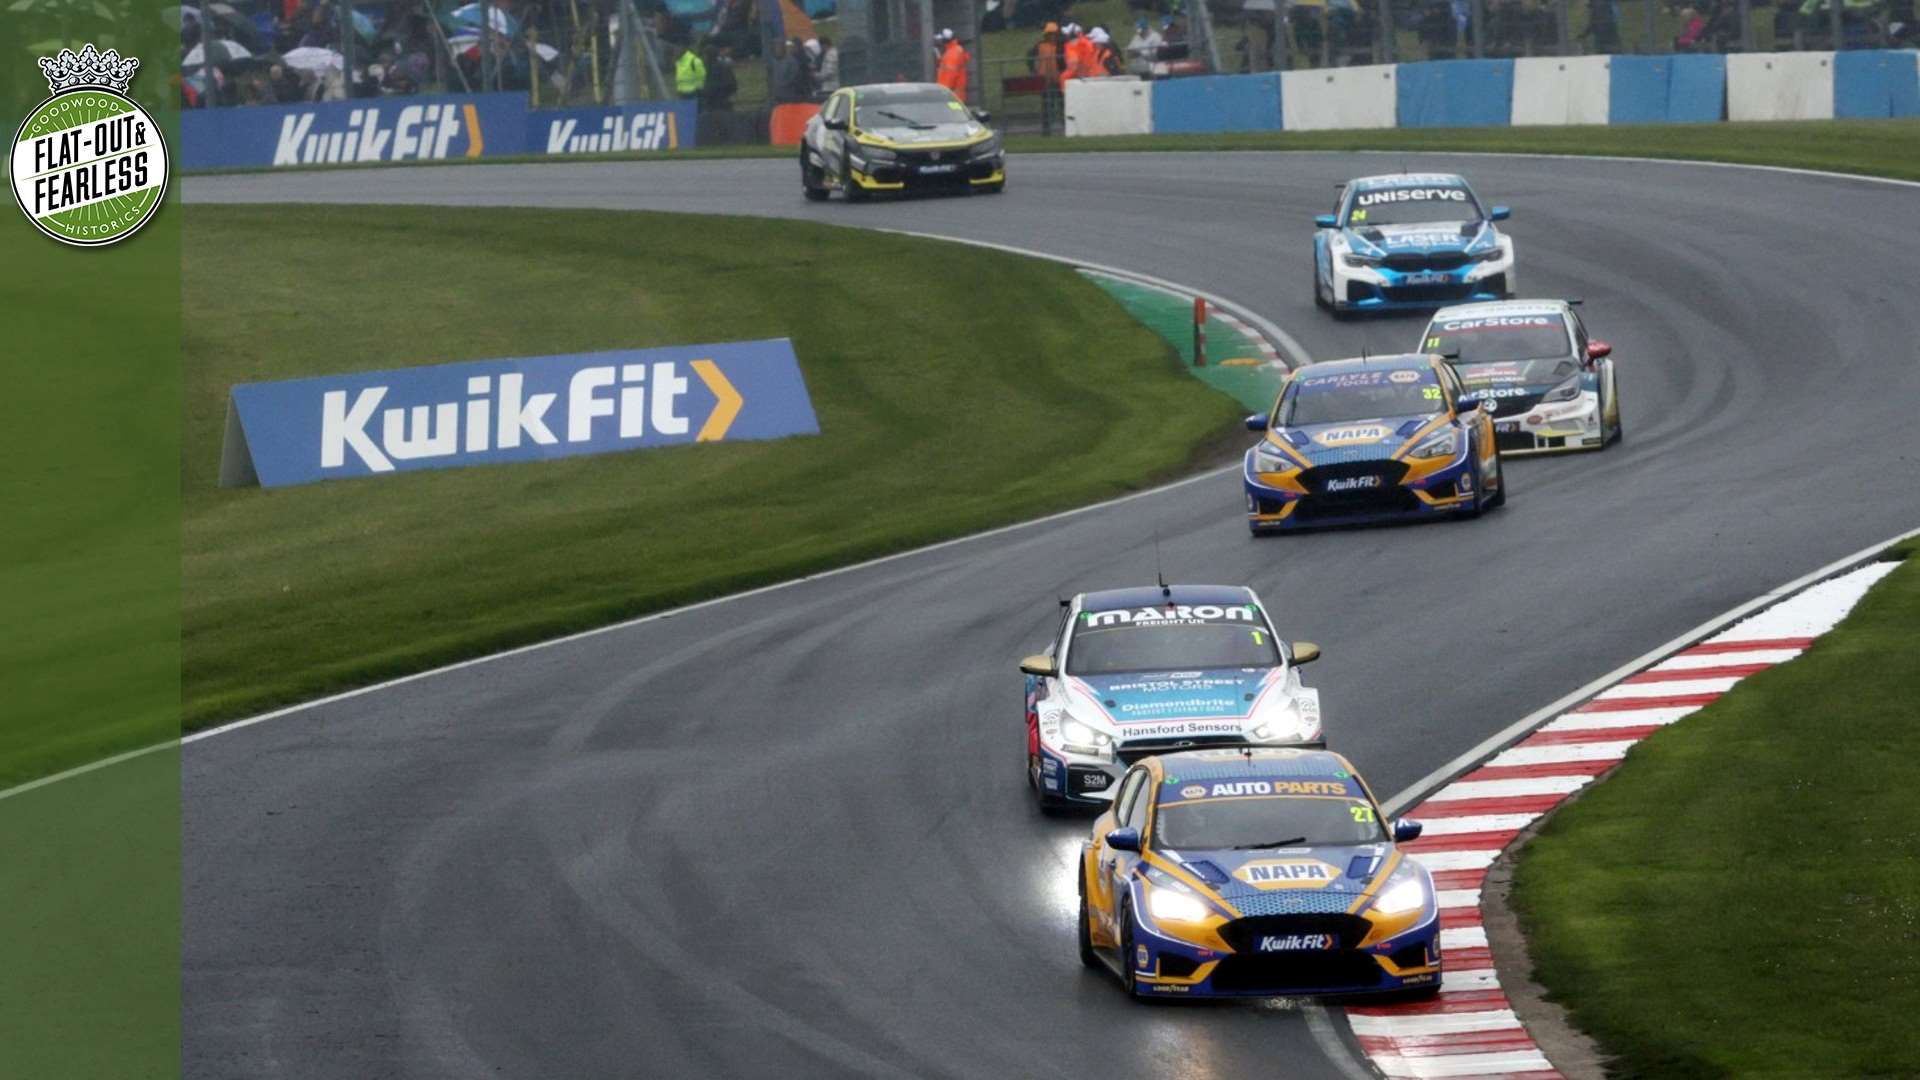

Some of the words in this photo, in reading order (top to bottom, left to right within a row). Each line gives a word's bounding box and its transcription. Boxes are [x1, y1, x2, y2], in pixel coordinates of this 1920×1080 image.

[1444, 316, 1549, 331] CarStore
[1422, 388, 1441, 400] 32
[1326, 428, 1380, 441] NAPA
[1135, 619, 1184, 627] FREIGHT
[1250, 631, 1264, 646] 1
[1109, 681, 1175, 691] BRISTOL
[1184, 679, 1245, 687] STREET
[1143, 685, 1212, 693] MOTORS
[1121, 698, 1236, 712] Diamondbrite
[1122, 724, 1185, 738] Hansford
[1188, 721, 1243, 733] Sensors
[1083, 774, 1107, 785] S2M
[1211, 781, 1270, 796] AUTO
[1274, 781, 1347, 795] PARTS
[1350, 806, 1375, 824] 27
[1249, 864, 1327, 881] NAPA
